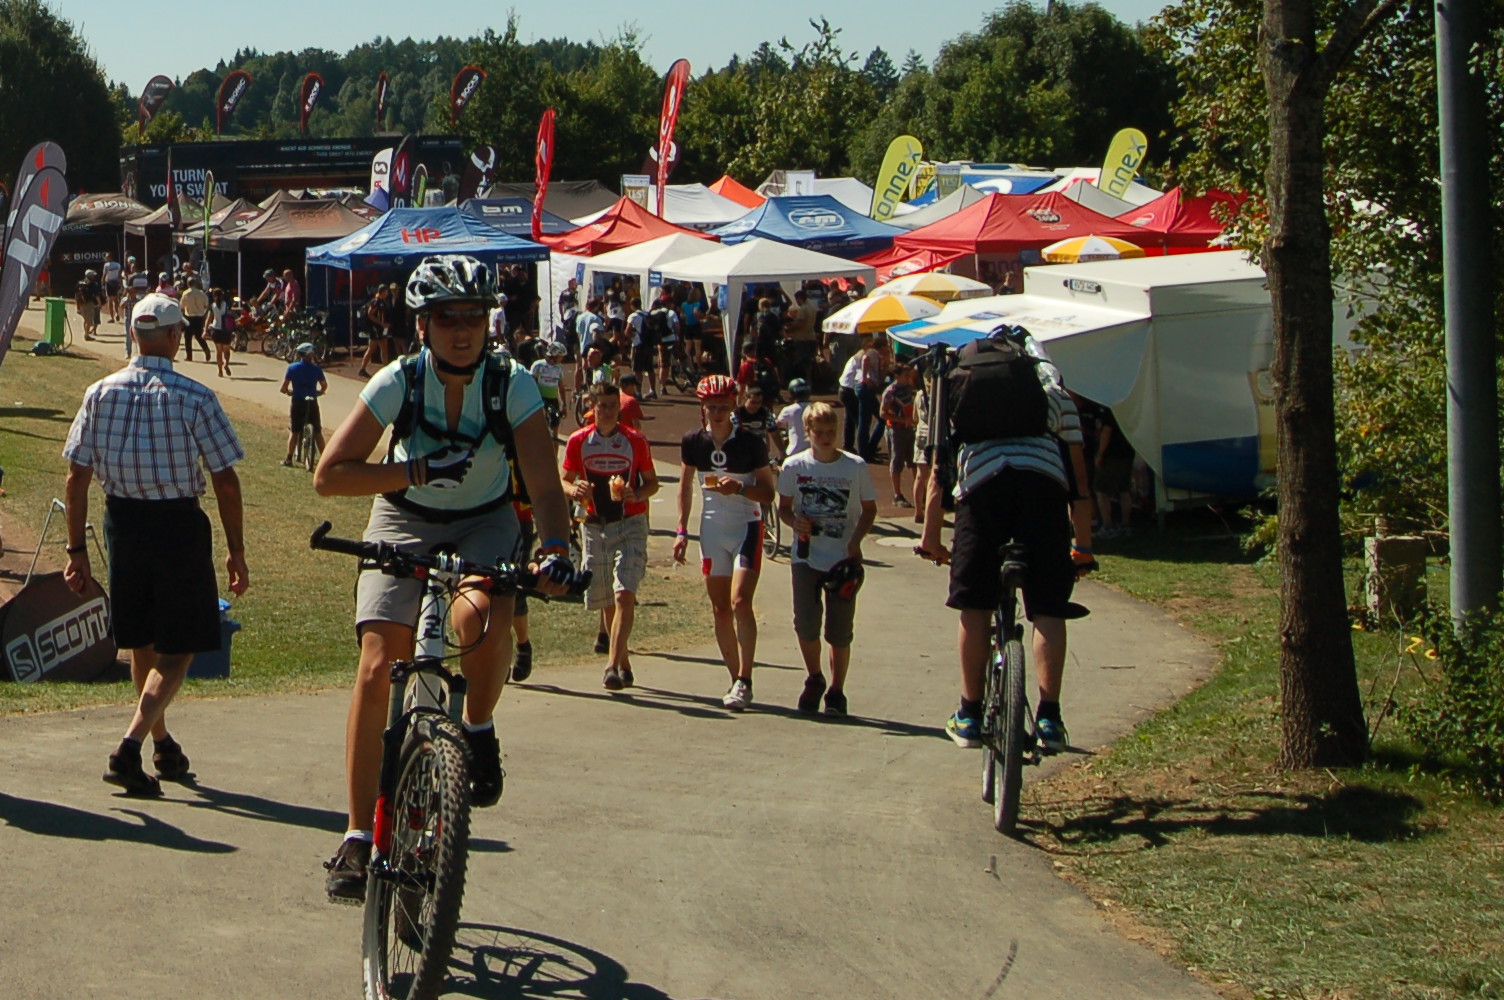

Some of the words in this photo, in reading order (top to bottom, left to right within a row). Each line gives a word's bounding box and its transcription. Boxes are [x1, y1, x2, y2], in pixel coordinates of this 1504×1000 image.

[173, 169, 205, 183] TURN
[150, 184, 182, 197] YOR
[187, 182, 228, 196] SWAT
[94, 201, 145, 210] BIONIC
[400, 227, 441, 244] HP
[35, 597, 108, 673] SCOTT
